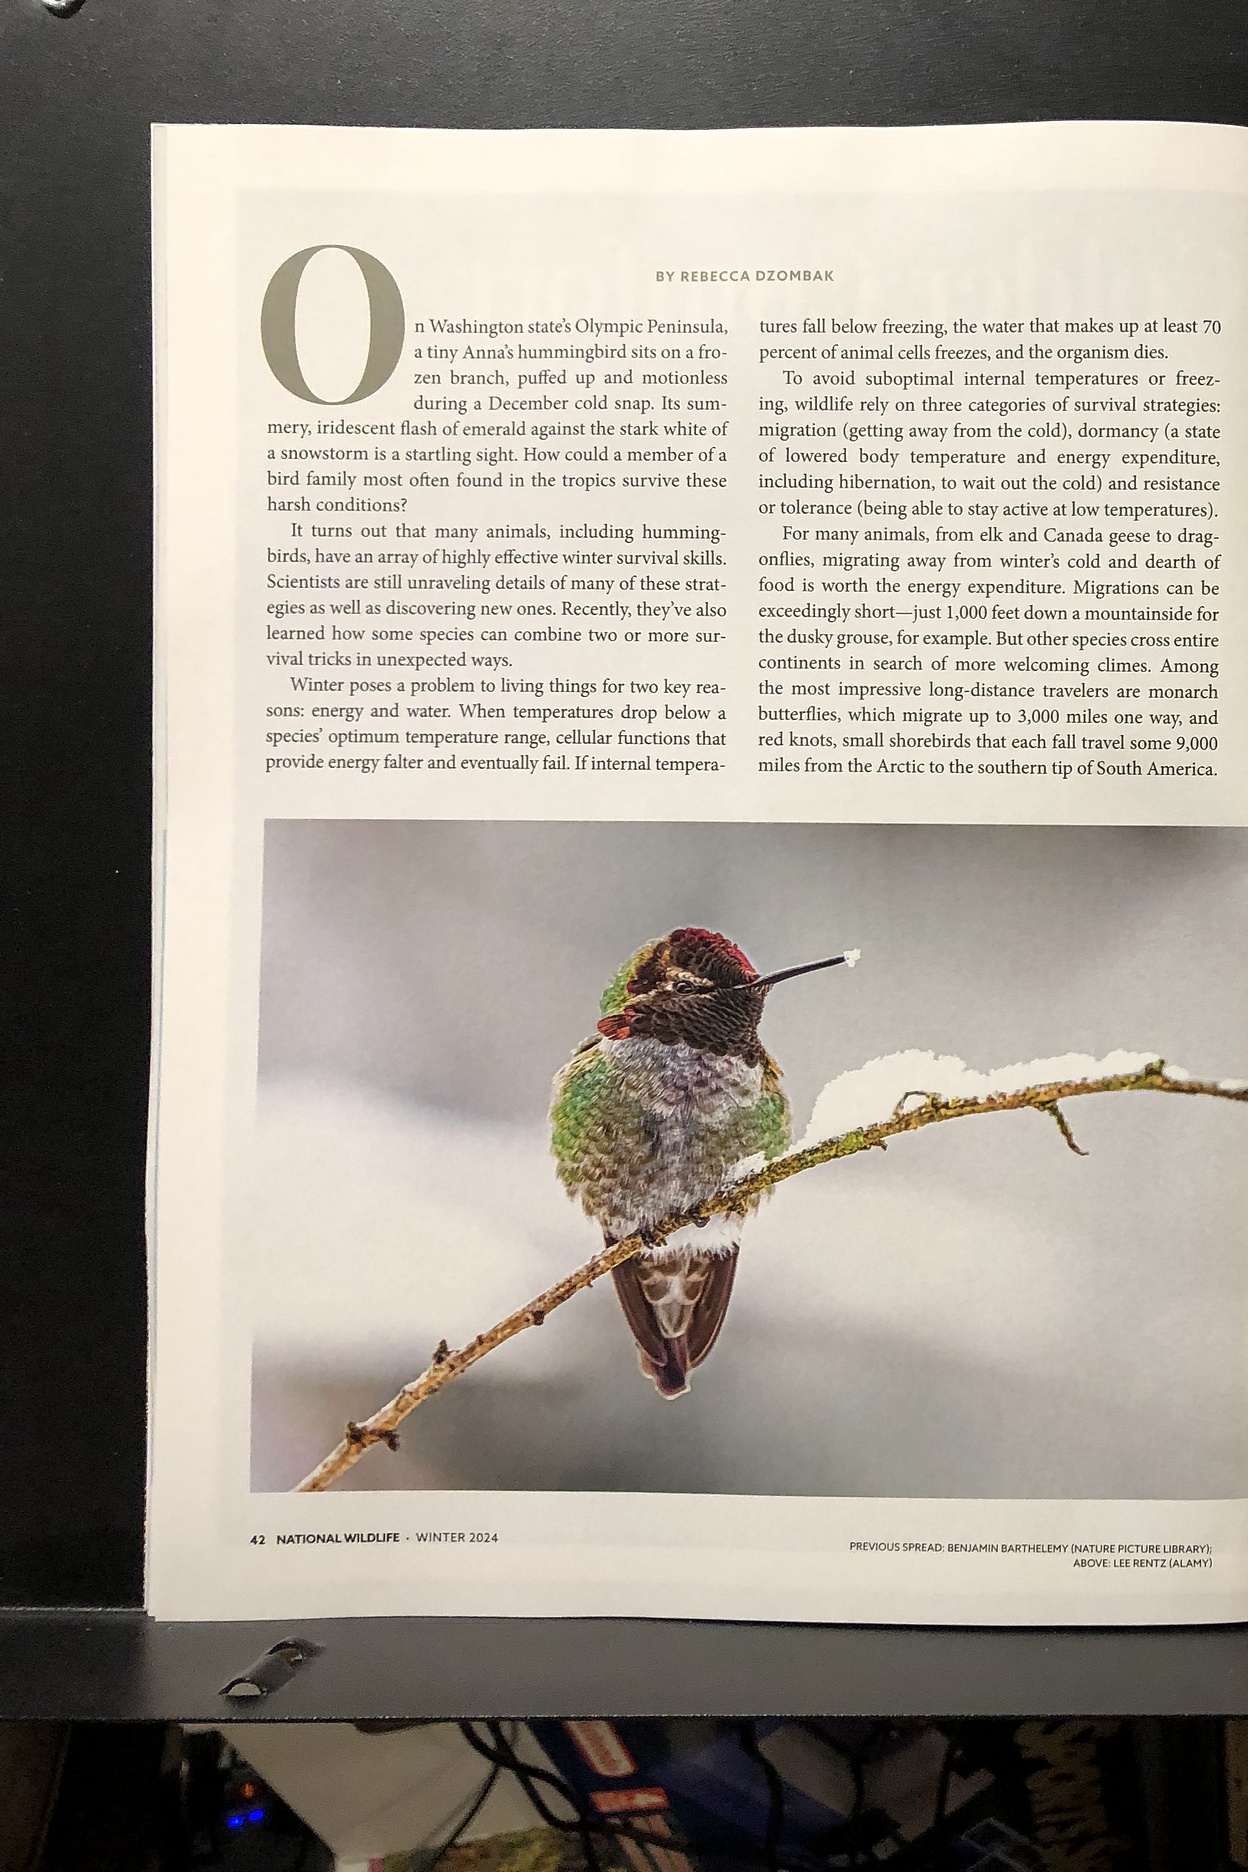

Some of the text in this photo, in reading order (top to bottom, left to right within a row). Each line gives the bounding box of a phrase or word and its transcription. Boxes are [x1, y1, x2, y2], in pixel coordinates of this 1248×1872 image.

[655, 270, 834, 282] BY REBECCA DZOMBAK
[414, 322, 425, 333] n
[428, 318, 524, 339] Washington
[575, 317, 644, 338] Olympic
[647, 318, 729, 336] Peninsula,
[759, 343, 1169, 364] percent of animal cells freezes, and the organism dies.
[267, 495, 408, 513] harsh conditions?
[758, 499, 1218, 522] or tolerance (being able to stay active at low temperatures).
[249, 1532, 499, 1546] 42 NATIONAL WILDLIFE WINTER 2024
[849, 1541, 1213, 1555] PREVIOUS SPREAD: BENJAMIN BARTHELEMY (NATURE PICTURE LIBRARY);
[1072, 1557, 1213, 1569] ABOVE: LEE RENTZ (ALAMY)
